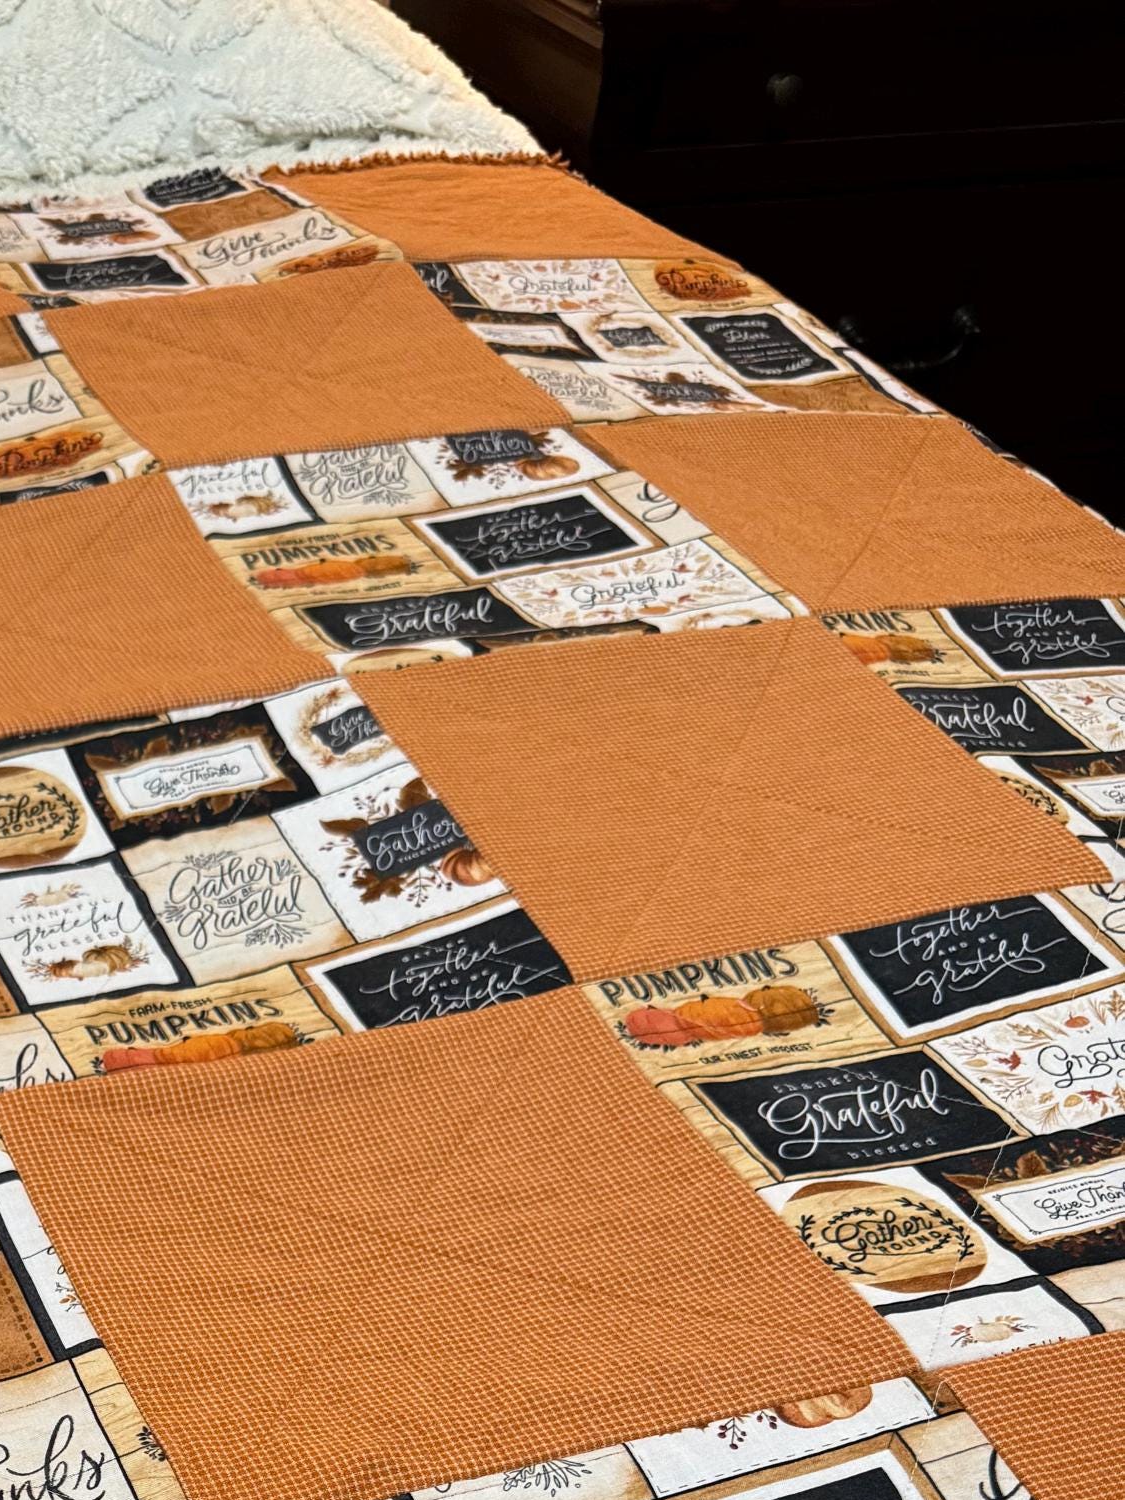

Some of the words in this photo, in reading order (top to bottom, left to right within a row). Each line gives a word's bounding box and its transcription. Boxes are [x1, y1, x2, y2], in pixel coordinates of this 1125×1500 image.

[509, 273, 598, 296] Grateful
[240, 534, 397, 570] PUMPKINS
[344, 599, 495, 647] Grateful
[328, 713, 366, 747] Give
[144, 778, 181, 798] Give
[180, 763, 240, 785] Thanks
[35, 930, 120, 953] BLESSED
[869, 904, 1043, 963] together
[359, 940, 543, 1000] together
[599, 947, 801, 1009] PUMPKINS
[893, 934, 1068, 1005] grateful
[128, 996, 213, 1018] FARM-FRESH
[375, 966, 559, 1029] grateful
[85, 998, 285, 1047] PUMPKINS
[699, 1052, 724, 1066] OUR
[725, 1046, 763, 1064] FINEST
[758, 1068, 950, 1159] Grateful
[847, 1138, 938, 1160] blessed
[1034, 1198, 1081, 1221] Give
[821, 1209, 933, 1263] Gather
